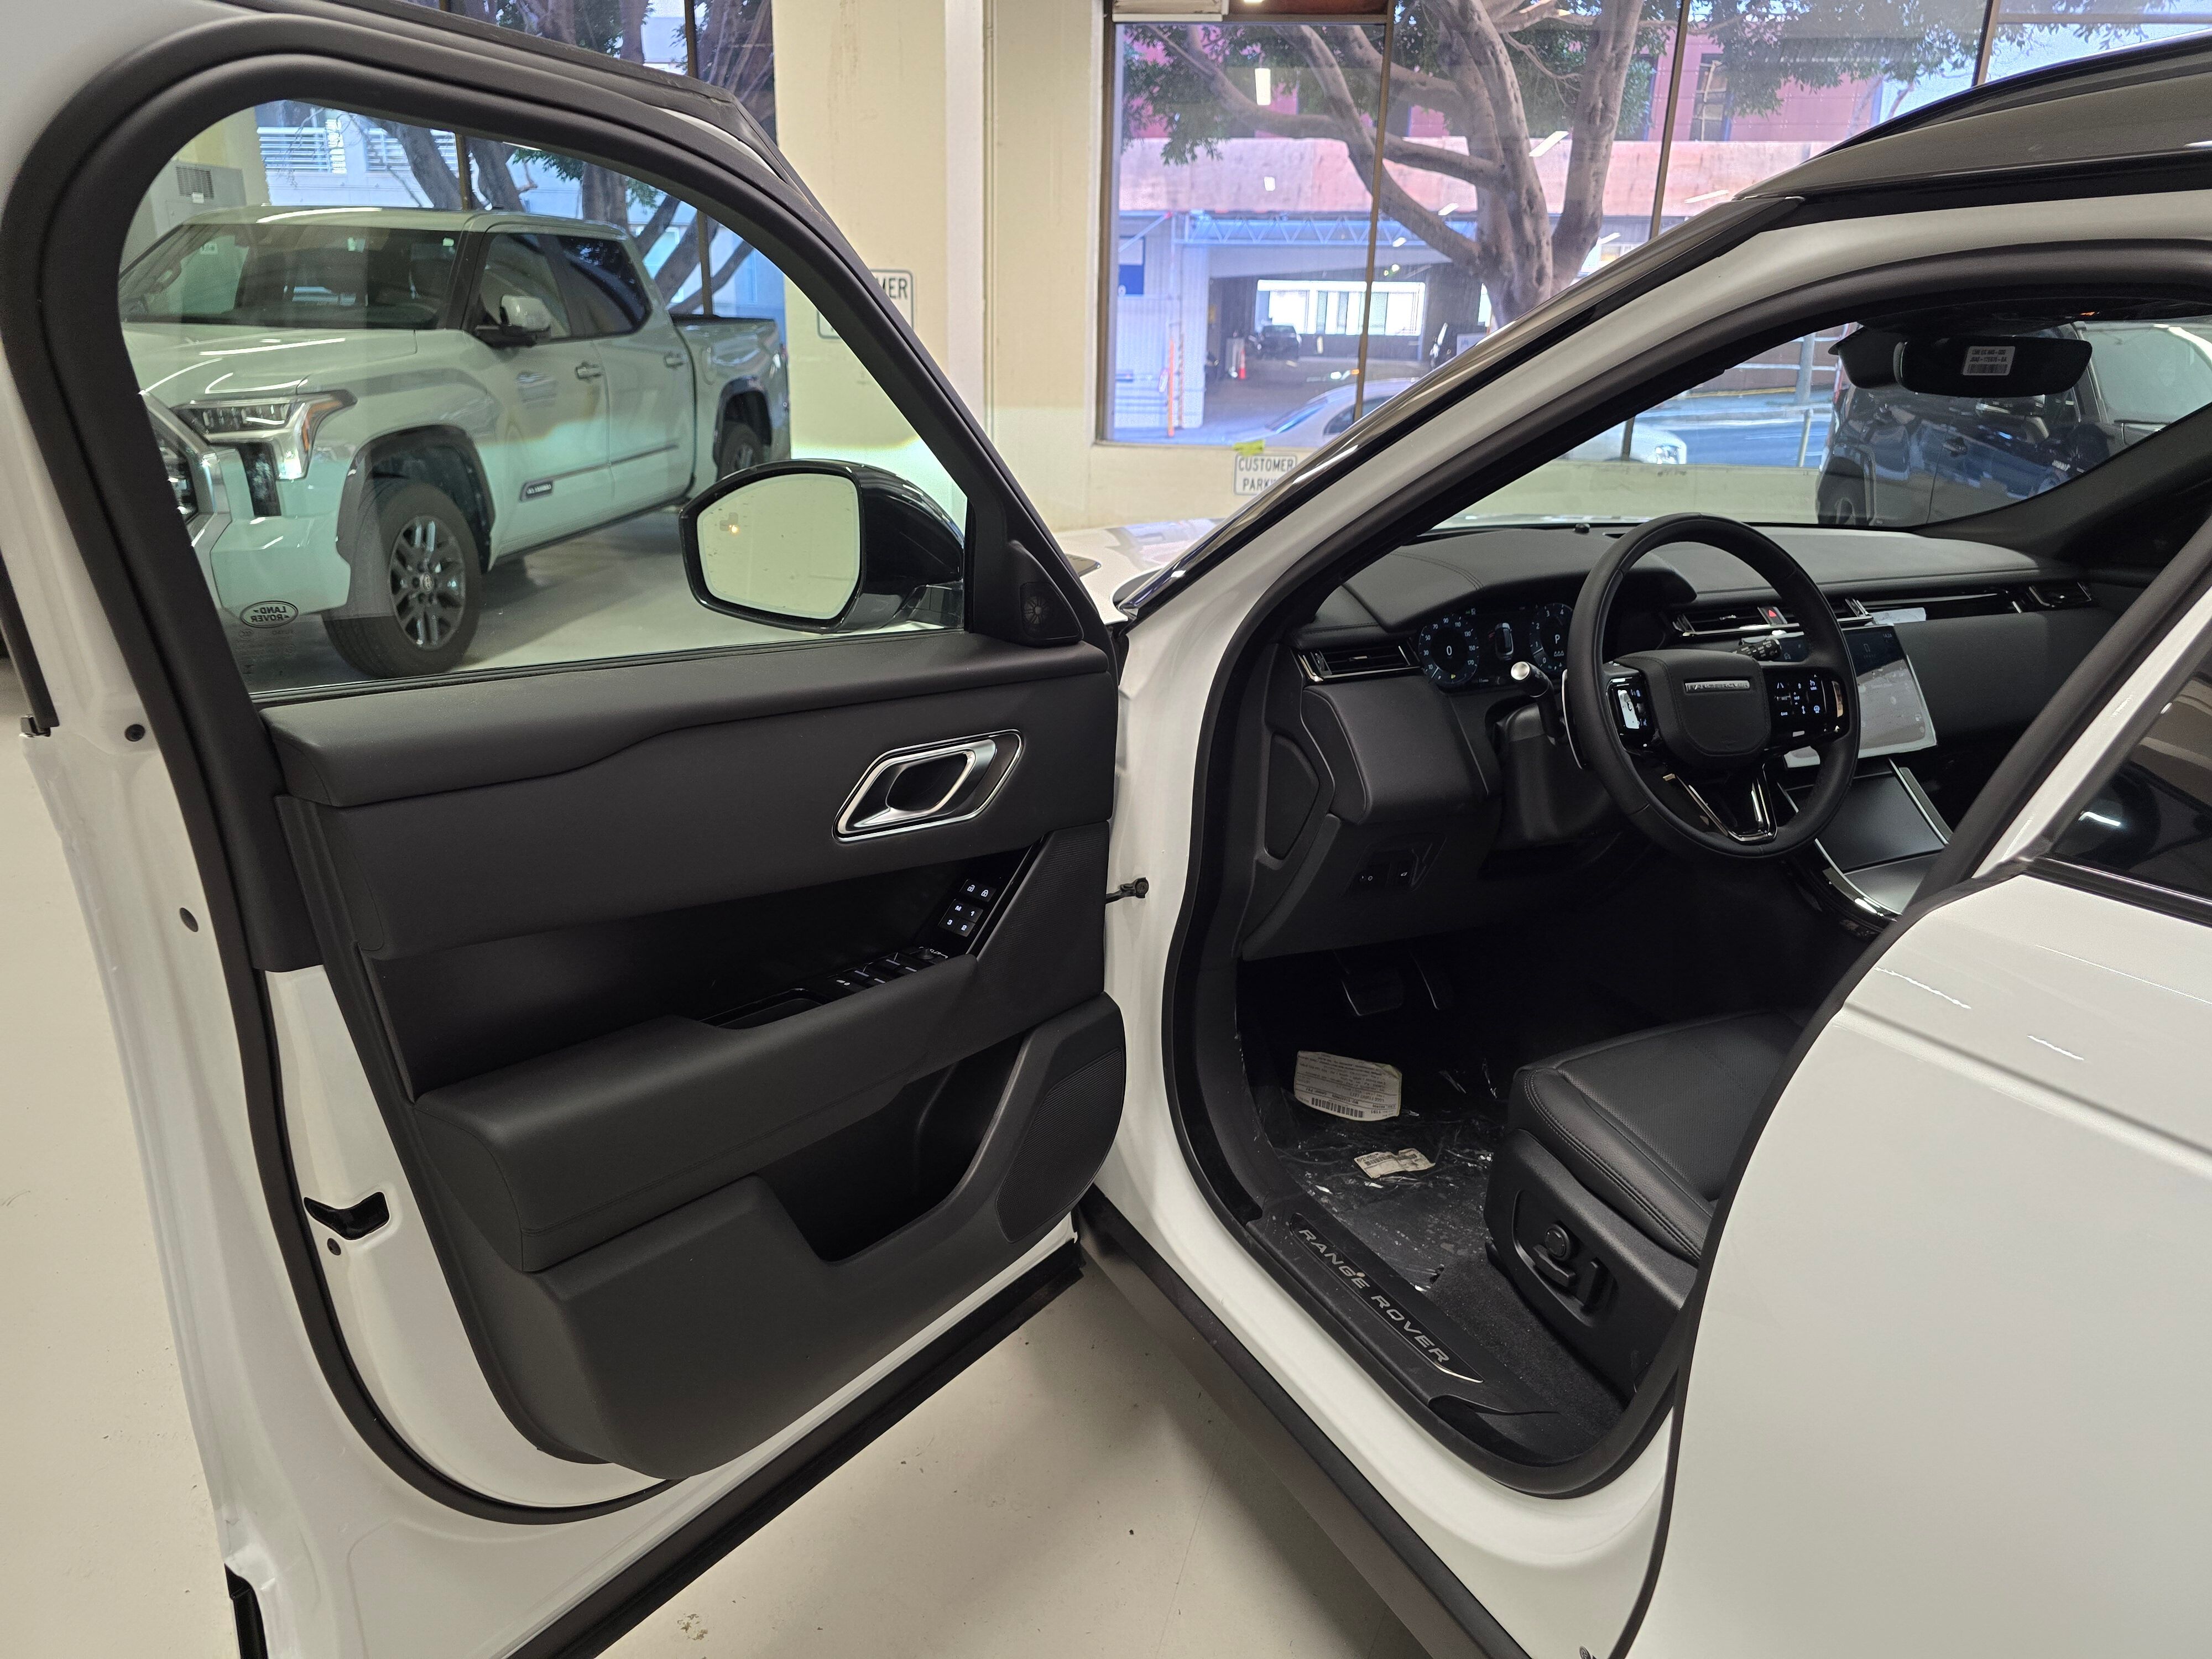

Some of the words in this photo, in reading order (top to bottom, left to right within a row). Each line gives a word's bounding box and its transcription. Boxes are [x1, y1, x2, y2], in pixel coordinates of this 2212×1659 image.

[1238, 457, 1294, 471] CUSTOMER
[1242, 477, 1277, 491] PARK
[1555, 634, 1560, 644] P
[1447, 645, 1452, 655] 0
[1299, 1229, 1370, 1289] RANGE
[1371, 1295, 1449, 1363] ROVER
